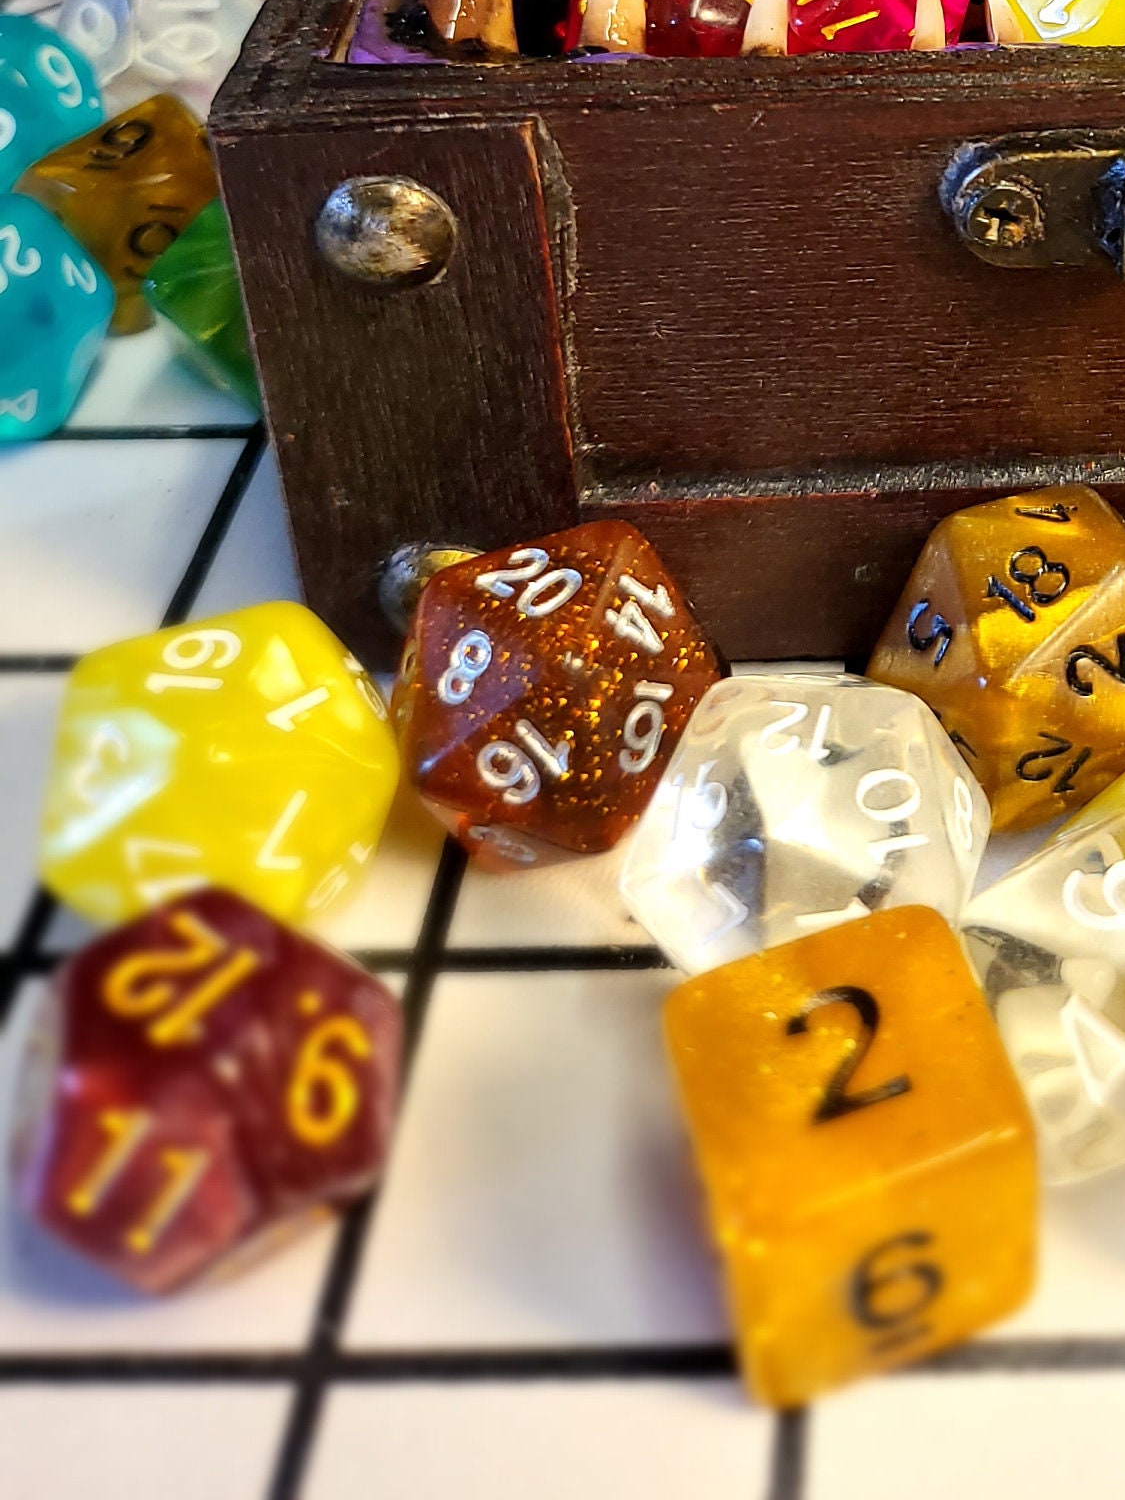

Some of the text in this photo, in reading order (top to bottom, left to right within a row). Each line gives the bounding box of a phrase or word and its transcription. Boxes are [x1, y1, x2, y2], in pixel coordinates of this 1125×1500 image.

[820, 9, 882, 42] 1
[60, 251, 98, 296] 2
[473, 547, 583, 619] 20
[604, 573, 676, 655] 14
[985, 545, 1071, 624] 18
[143, 628, 243, 696] 19
[436, 629, 493, 706] 8
[906, 597, 954, 668] 5
[265, 685, 331, 733] 1
[758, 699, 833, 762] 12
[1015, 729, 1095, 795] 12
[255, 788, 308, 871] 7
[855, 767, 931, 867] 10
[101, 909, 260, 1049] 12
[785, 985, 913, 1128] 2
[67, 1106, 208, 1256] 11
